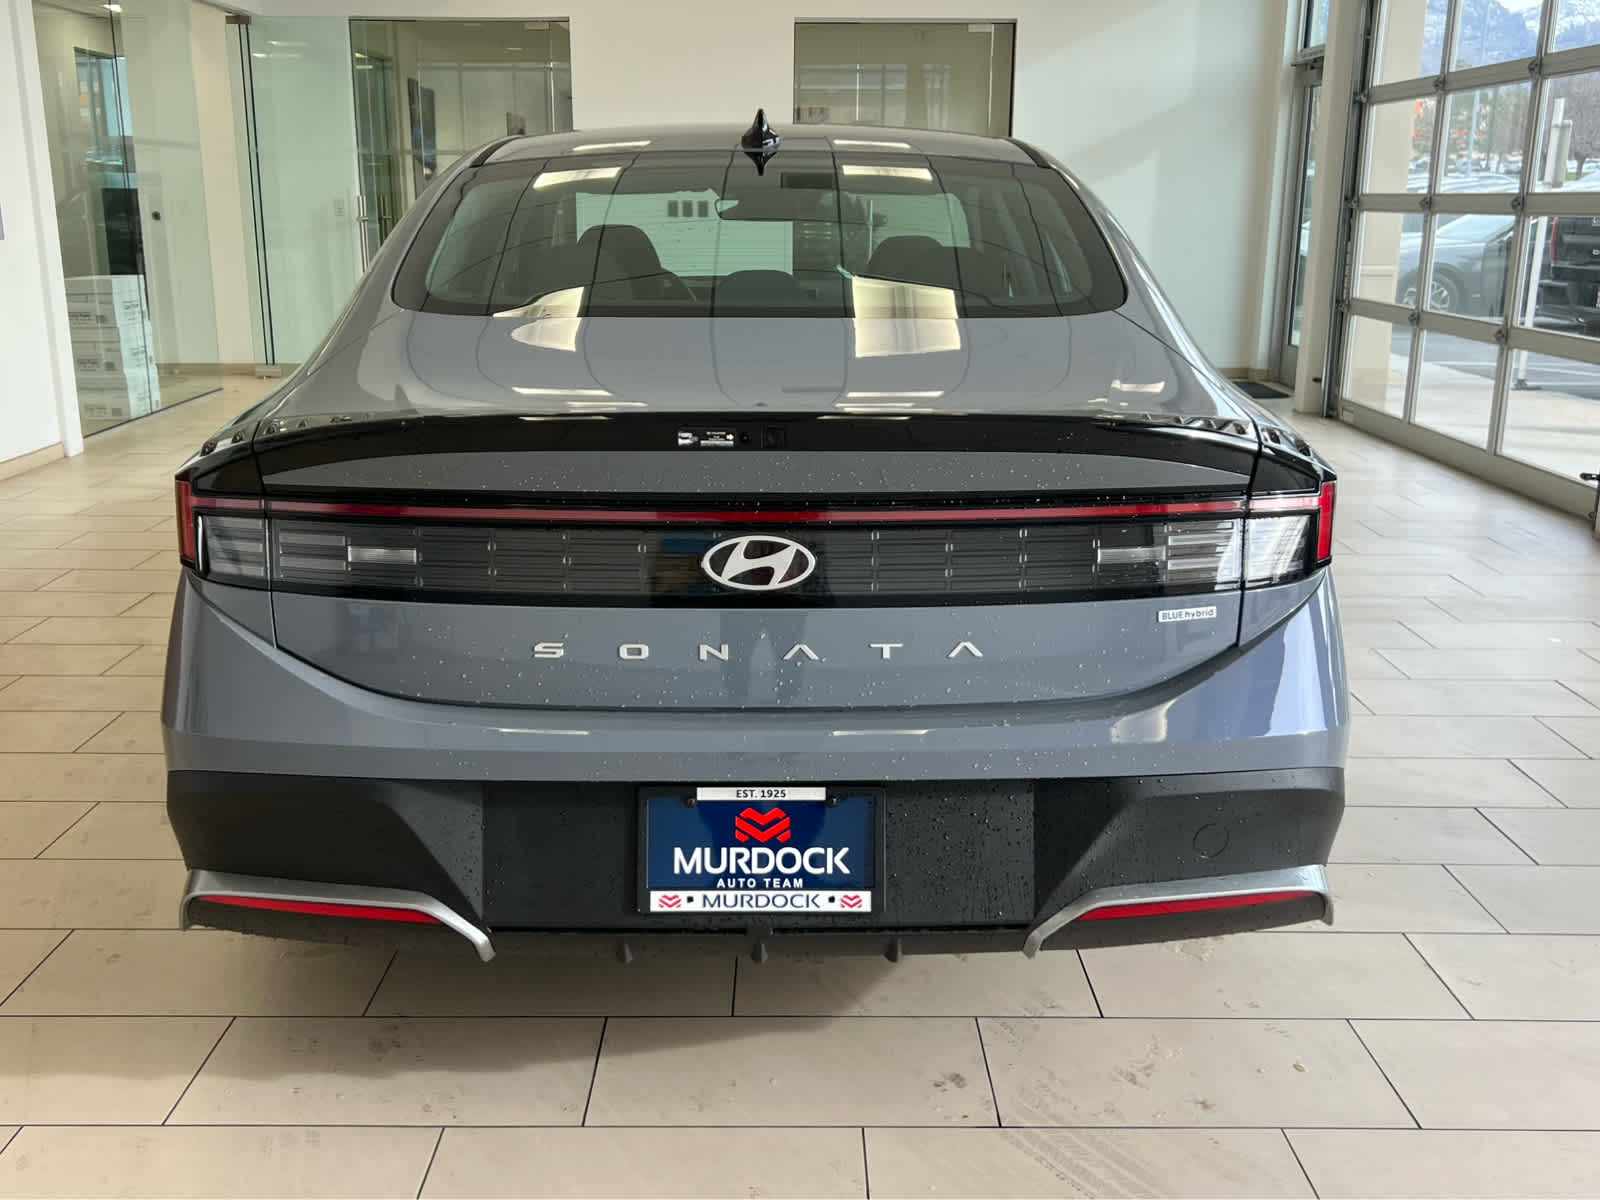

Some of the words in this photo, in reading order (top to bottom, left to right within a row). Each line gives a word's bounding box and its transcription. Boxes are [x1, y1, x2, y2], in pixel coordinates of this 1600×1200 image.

[534, 641, 983, 661] SONATA
[736, 789, 758, 798] EST.
[760, 789, 787, 798] 1925
[673, 847, 850, 875] MURDOCK
[717, 878, 756, 889] AUTO
[763, 878, 803, 889] TEAM
[702, 894, 821, 909] MURDOCK
